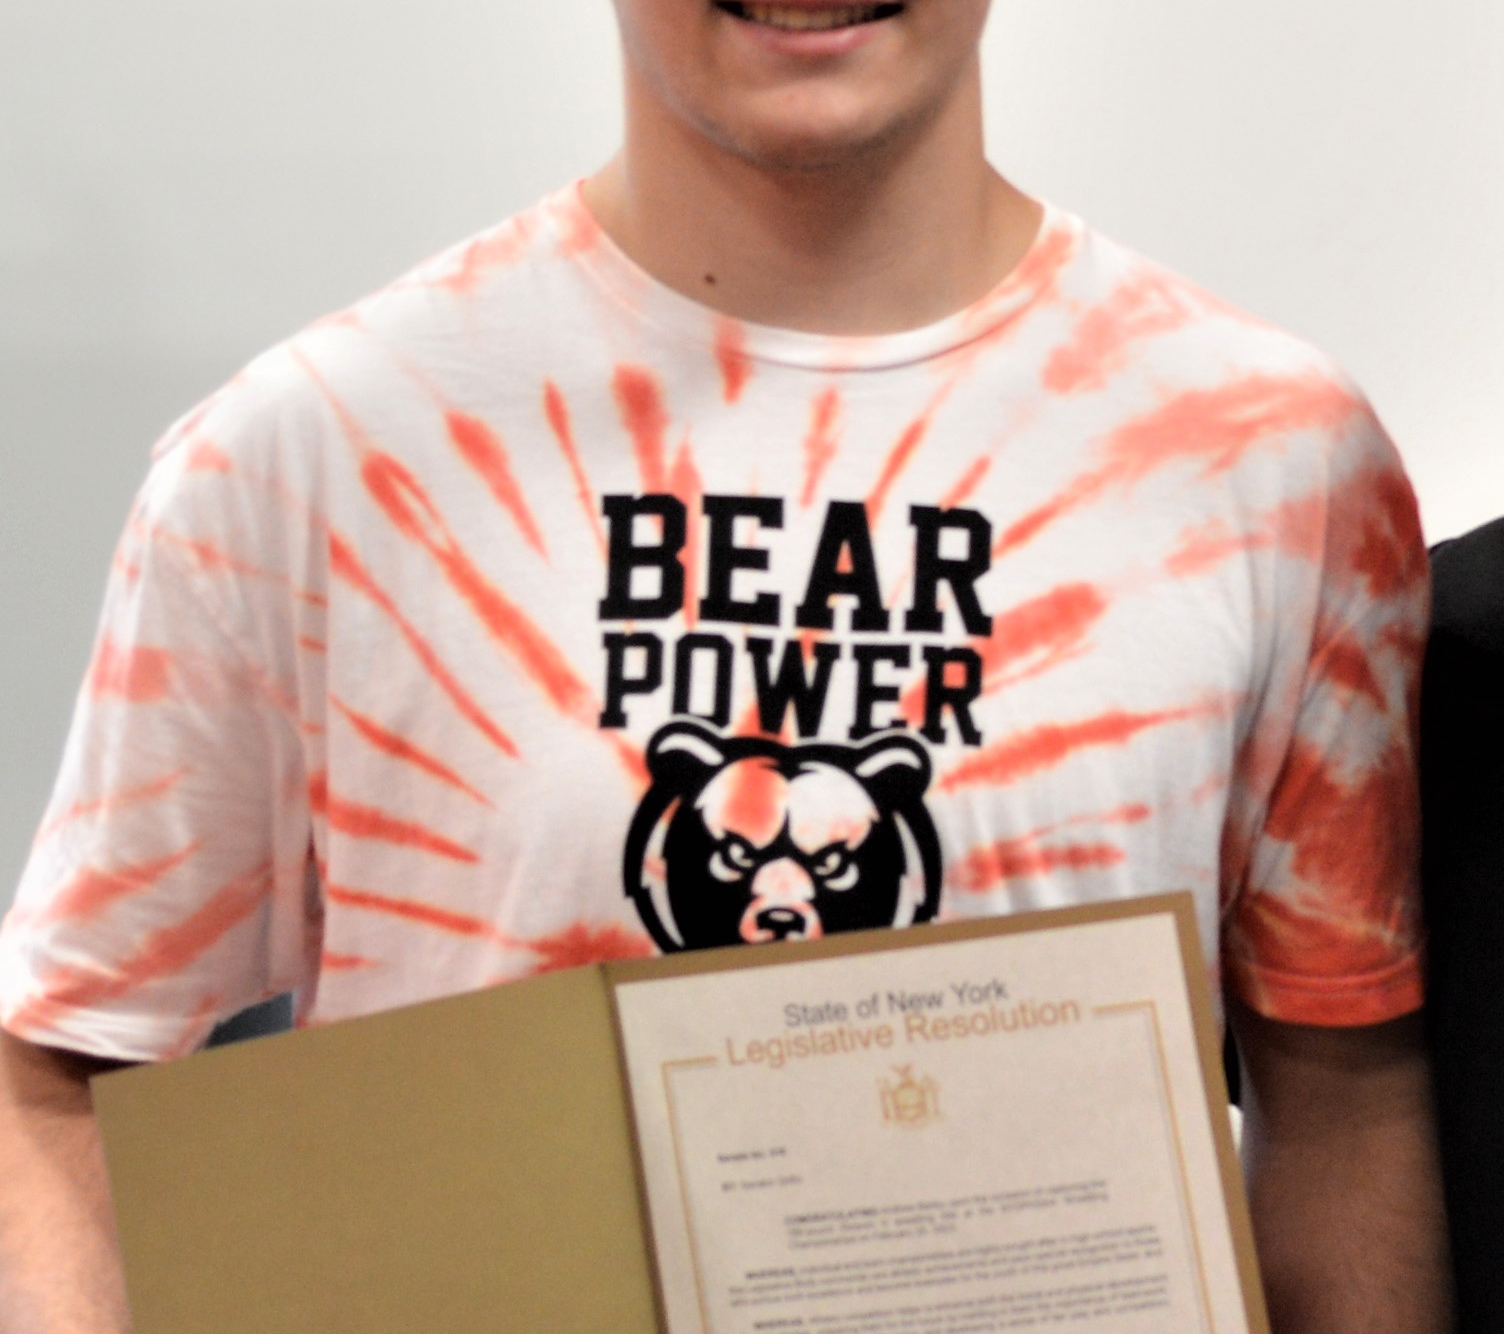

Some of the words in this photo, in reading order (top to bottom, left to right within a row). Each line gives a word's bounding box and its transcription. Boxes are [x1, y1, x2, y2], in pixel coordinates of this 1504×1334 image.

[597, 493, 994, 637] BEAR
[597, 631, 984, 747] POWER
[725, 1021, 895, 1069] Legislative
[904, 998, 1081, 1044] Resolution
[783, 1000, 850, 1028] State
[855, 993, 880, 1020] of
[886, 989, 944, 1014] New
[950, 979, 1009, 1005] York
